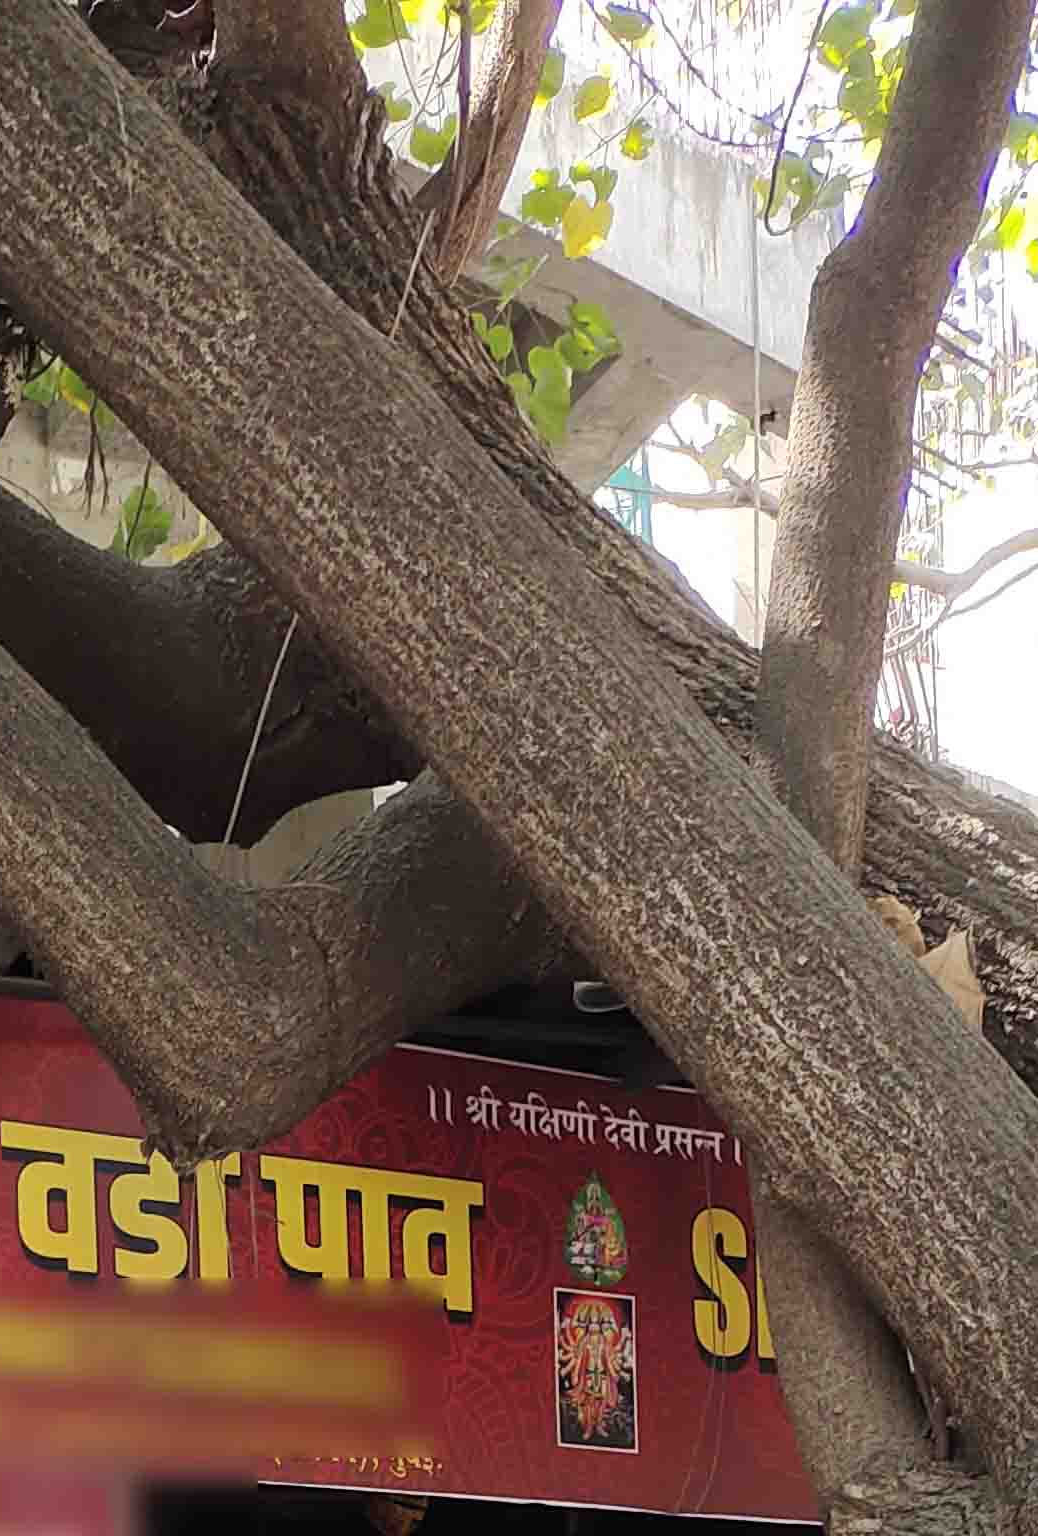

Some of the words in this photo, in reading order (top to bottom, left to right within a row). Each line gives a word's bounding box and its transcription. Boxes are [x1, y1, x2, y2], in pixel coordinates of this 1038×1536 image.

[465, 1085, 501, 1131] श्री
[599, 1103, 651, 1153] देवी
[259, 1154, 484, 1313] पाव
[691, 1207, 777, 1360] S
